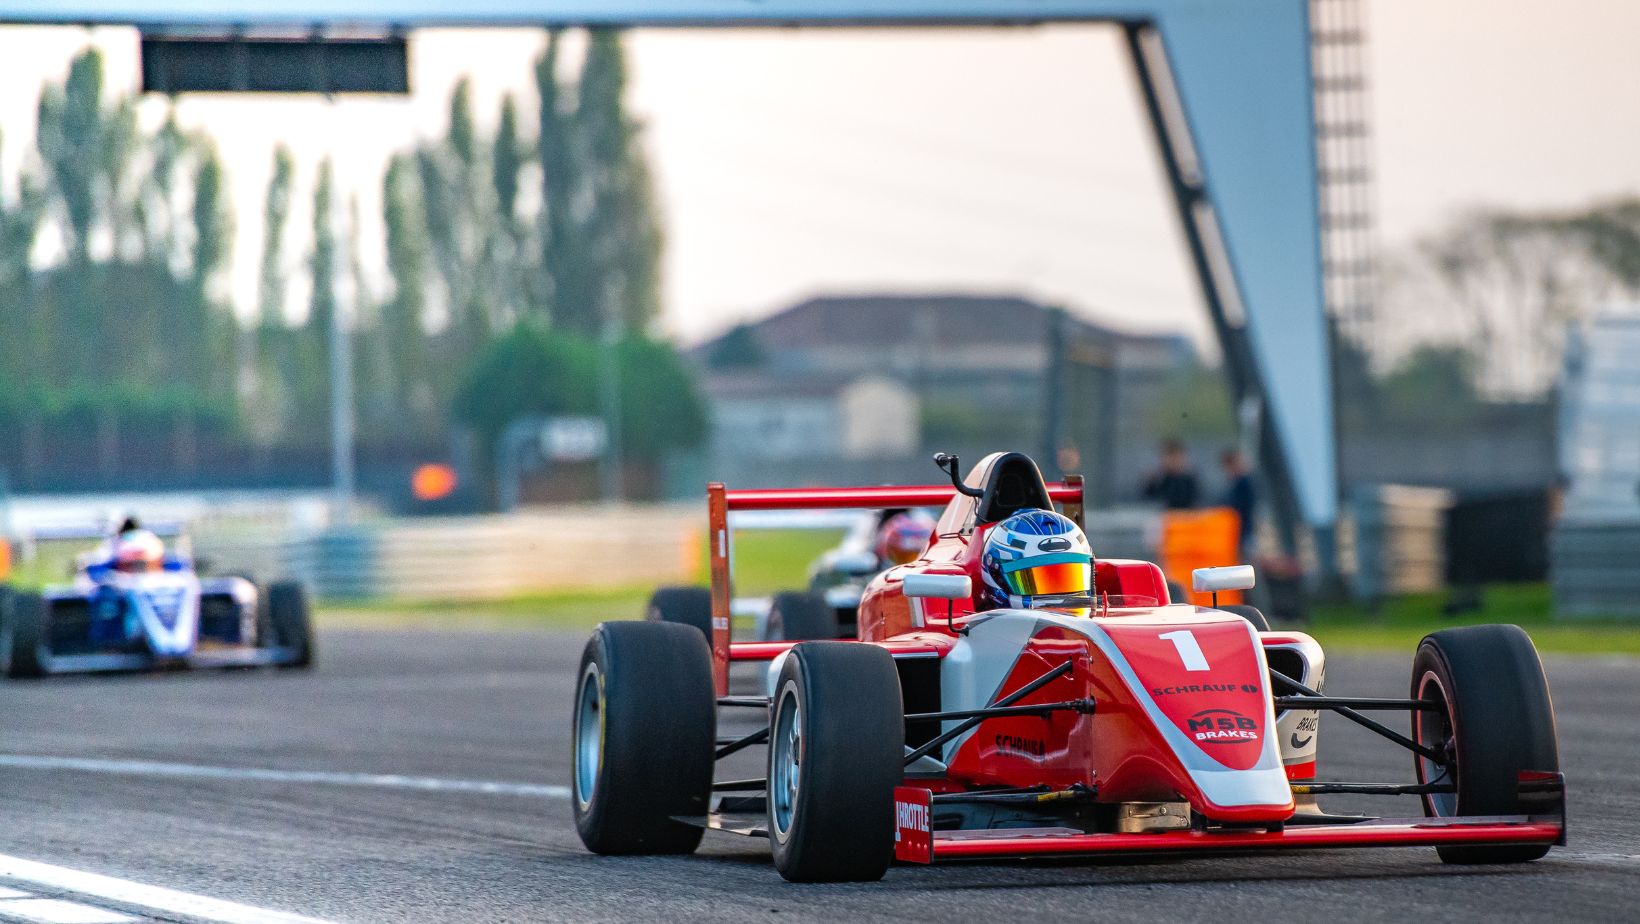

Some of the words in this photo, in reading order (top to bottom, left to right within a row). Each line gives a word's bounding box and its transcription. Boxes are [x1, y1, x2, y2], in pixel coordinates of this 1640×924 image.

[1158, 630, 1211, 671] 1
[1153, 684, 1236, 696] SCHRAUF
[1196, 730, 1258, 740] BRAKES
